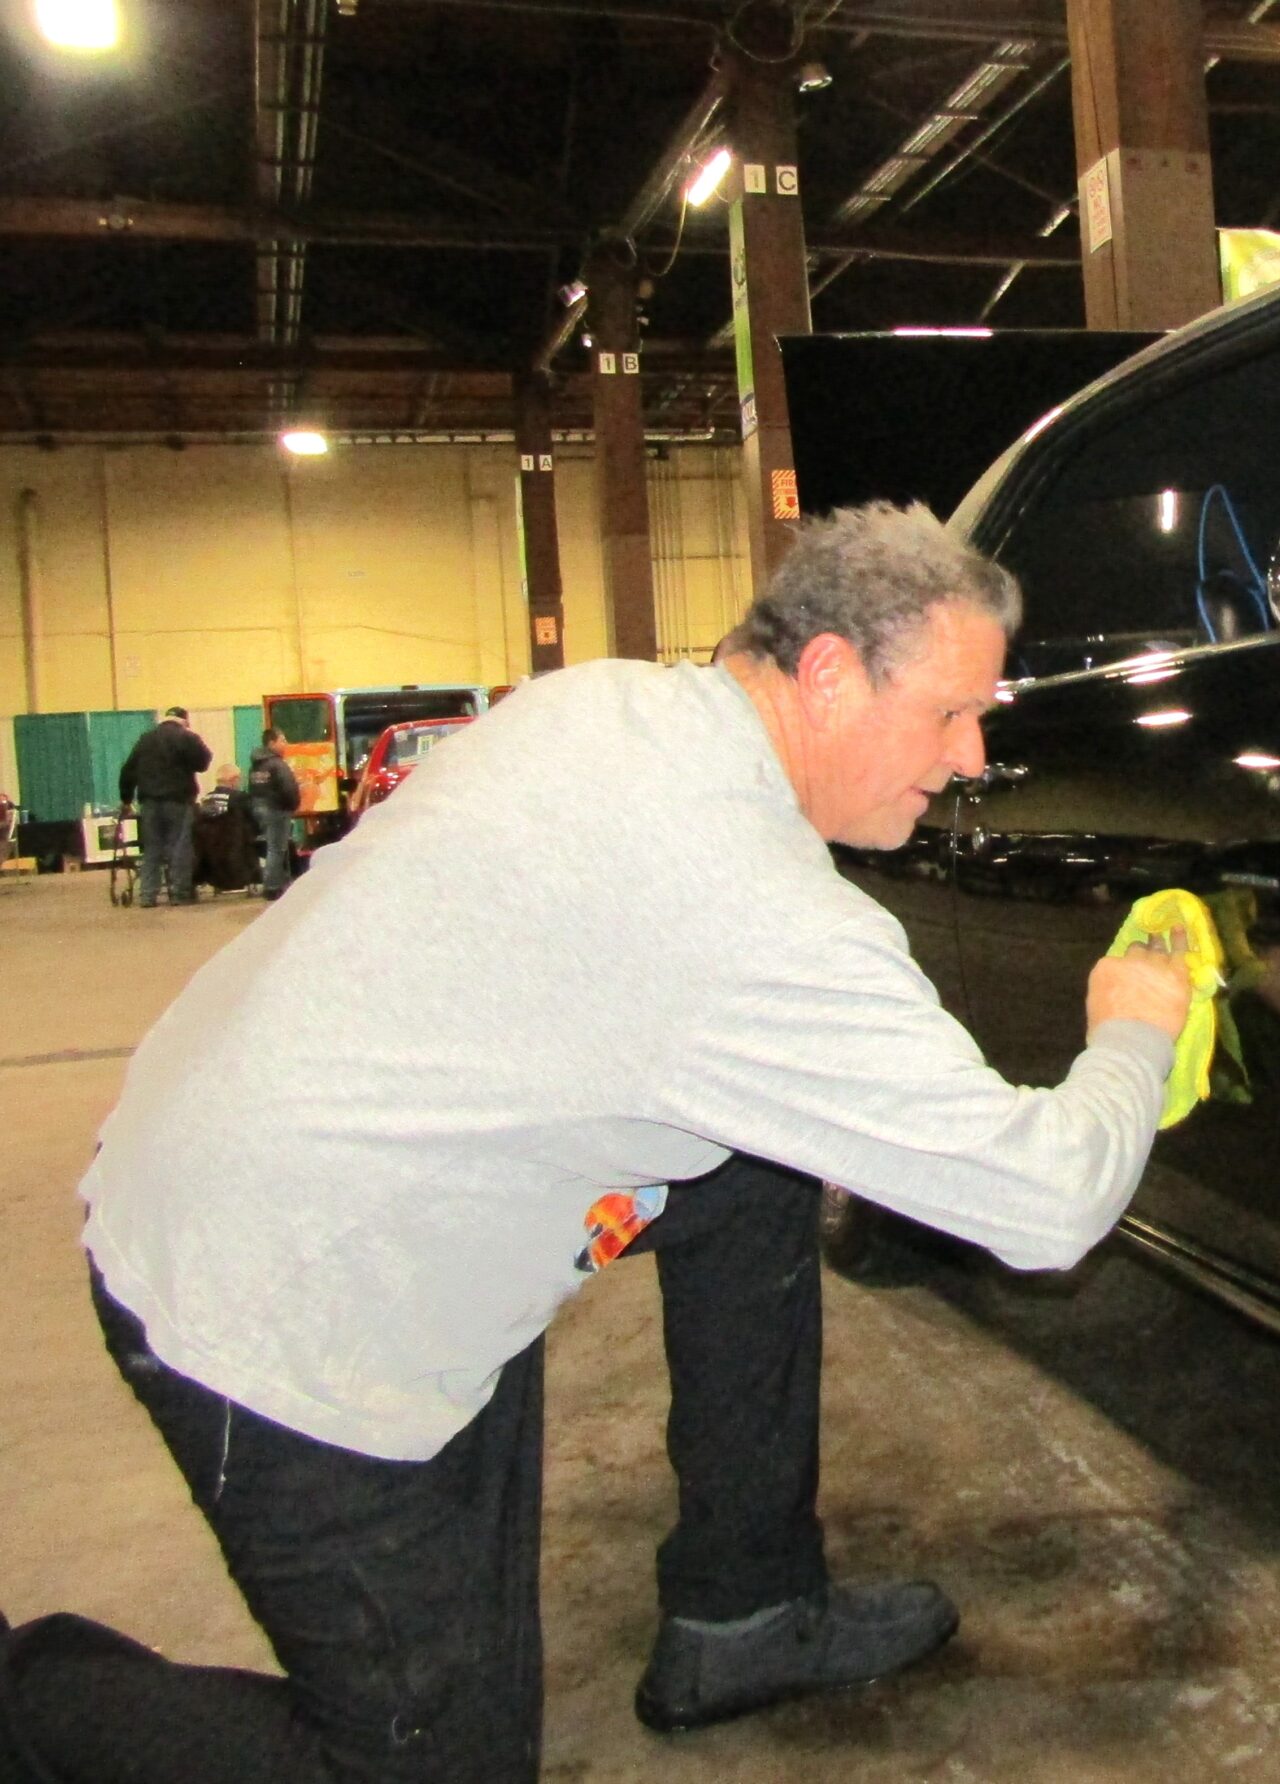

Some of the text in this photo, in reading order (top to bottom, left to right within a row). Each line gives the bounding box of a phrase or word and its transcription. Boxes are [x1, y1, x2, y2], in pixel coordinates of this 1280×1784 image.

[778, 170, 796, 190] C
[624, 356, 637, 370] B
[541, 457, 551, 468] A
